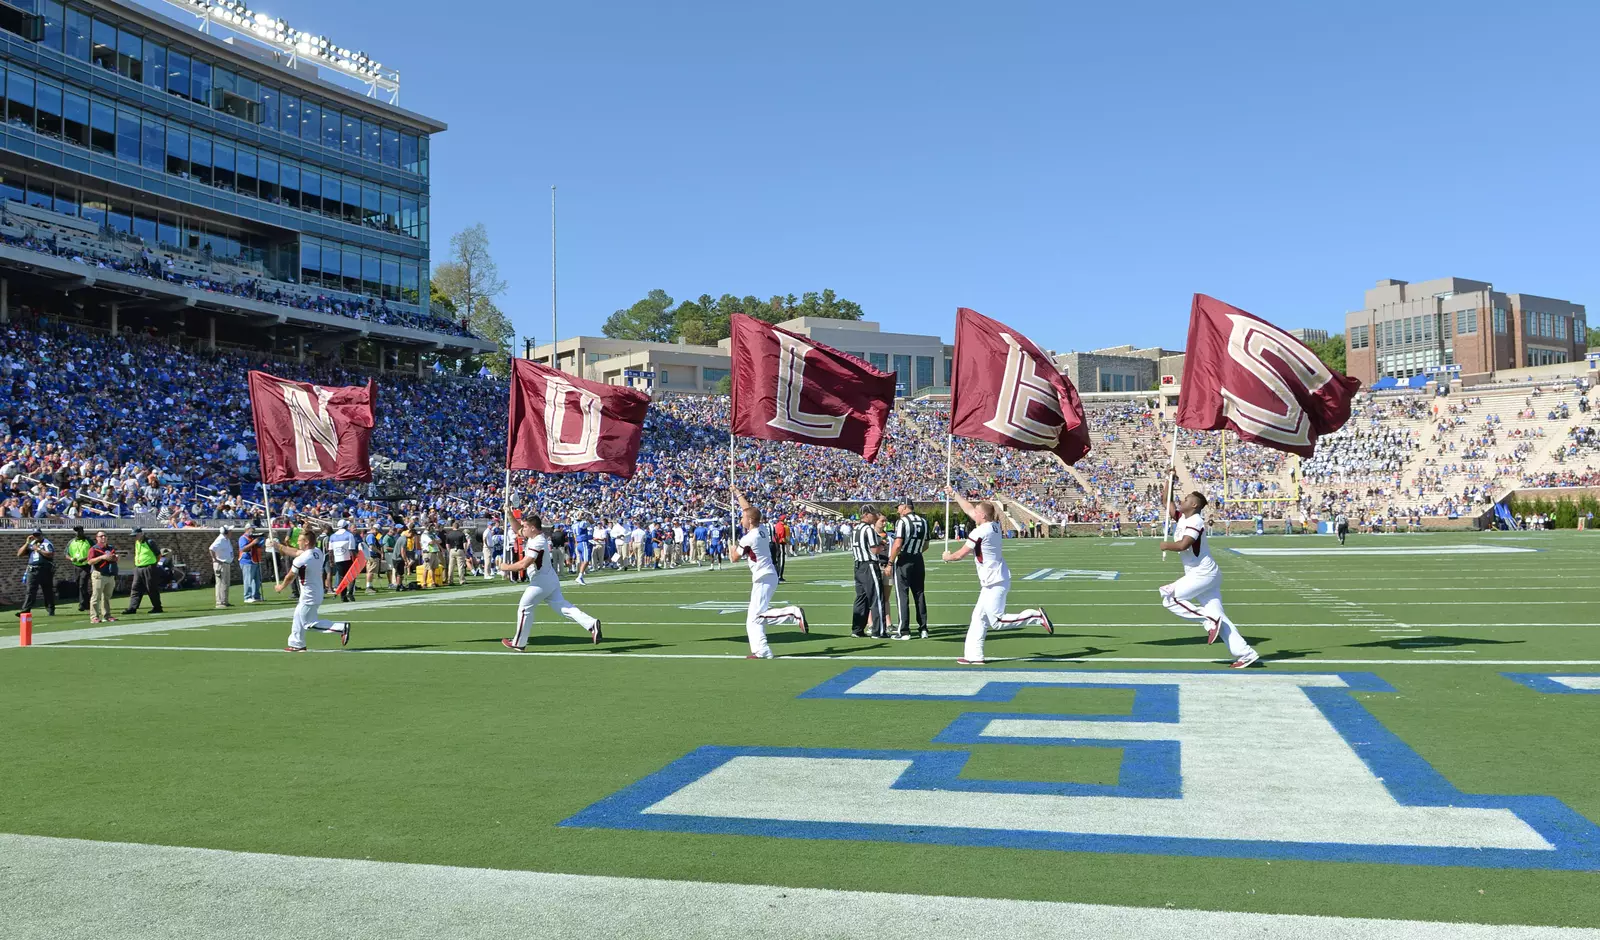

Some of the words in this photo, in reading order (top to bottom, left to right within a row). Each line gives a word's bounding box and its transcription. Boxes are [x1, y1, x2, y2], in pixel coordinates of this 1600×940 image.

[276, 382, 339, 473] N
[766, 329, 853, 438] L
[1220, 313, 1333, 446] S
[912, 521, 923, 538] F
